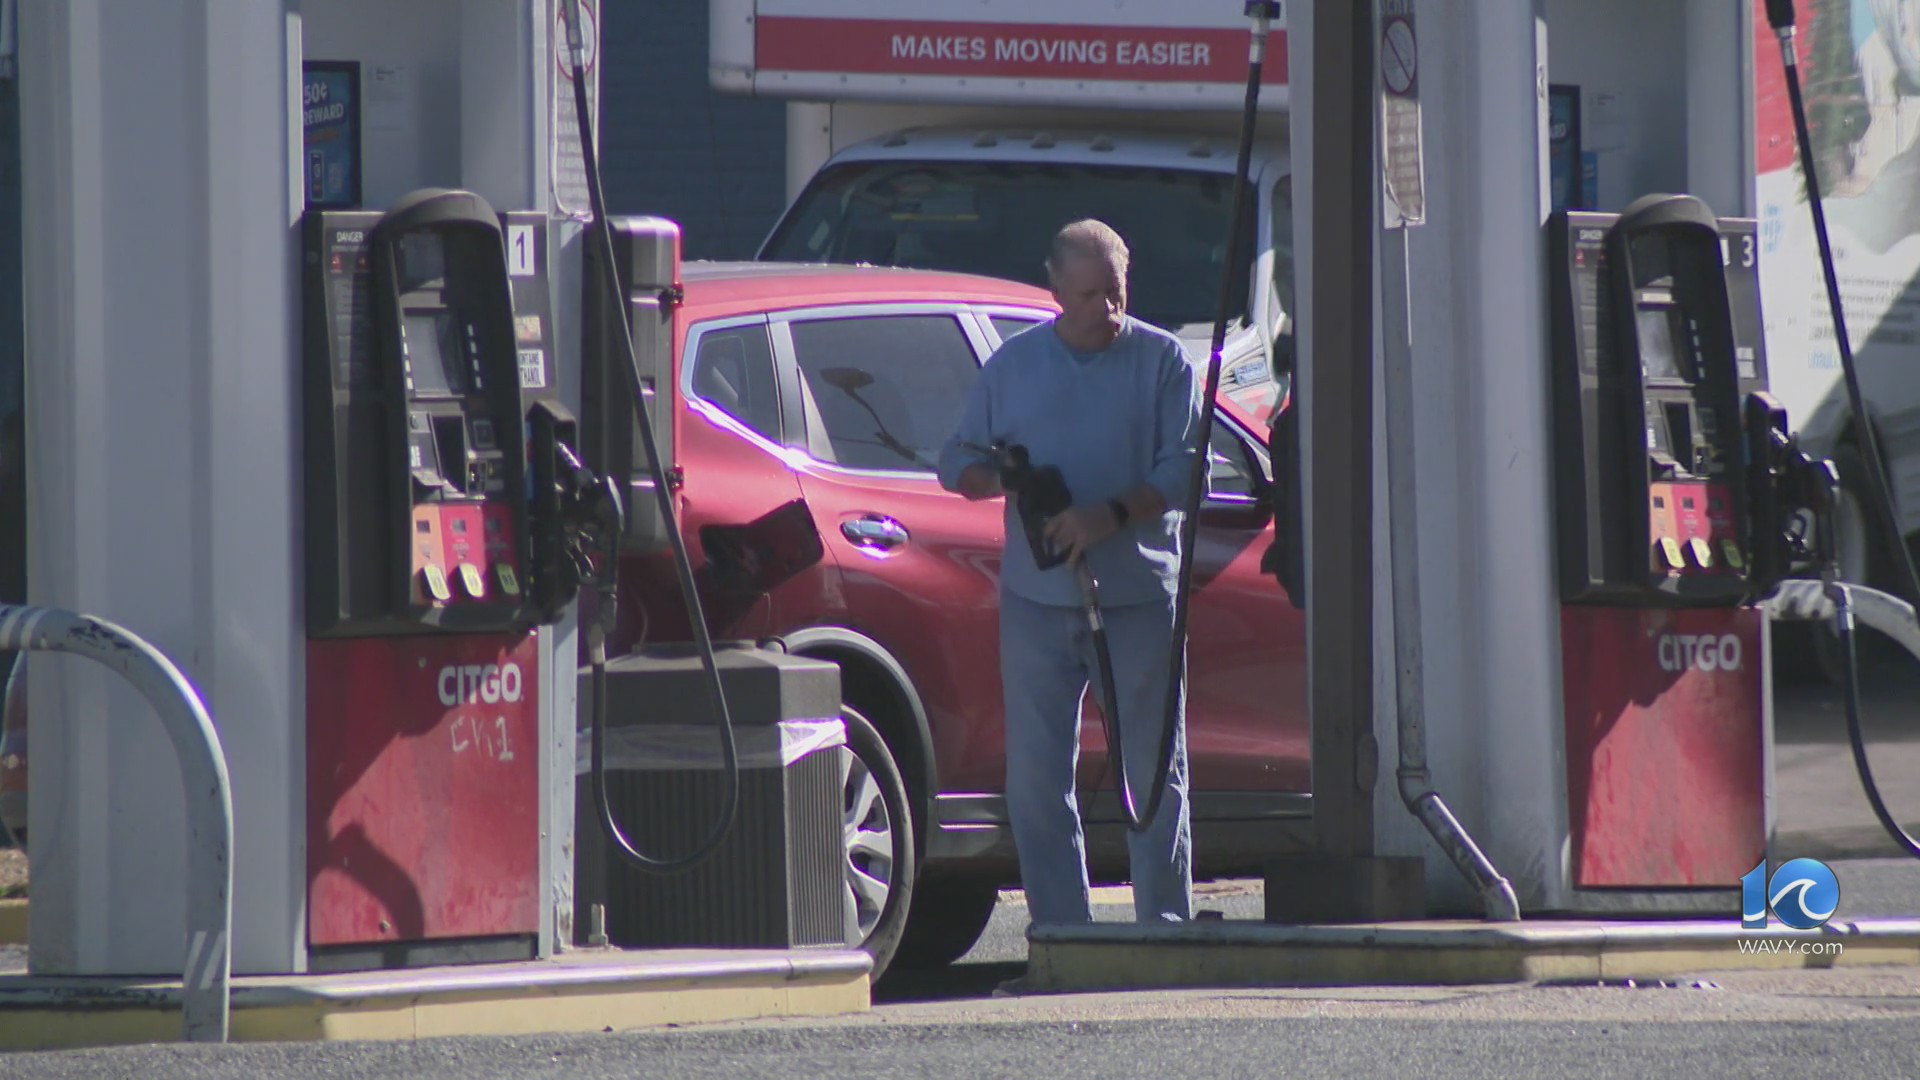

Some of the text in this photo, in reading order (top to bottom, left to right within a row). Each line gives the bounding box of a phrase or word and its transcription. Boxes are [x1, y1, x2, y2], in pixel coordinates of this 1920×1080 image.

[891, 36, 1211, 66] MAKES MOVING EASIER
[336, 231, 364, 242] DANGER
[516, 231, 526, 270] 1
[1741, 235, 1754, 268] 3
[1658, 633, 1742, 672] CITGO
[437, 662, 522, 706] CITGO
